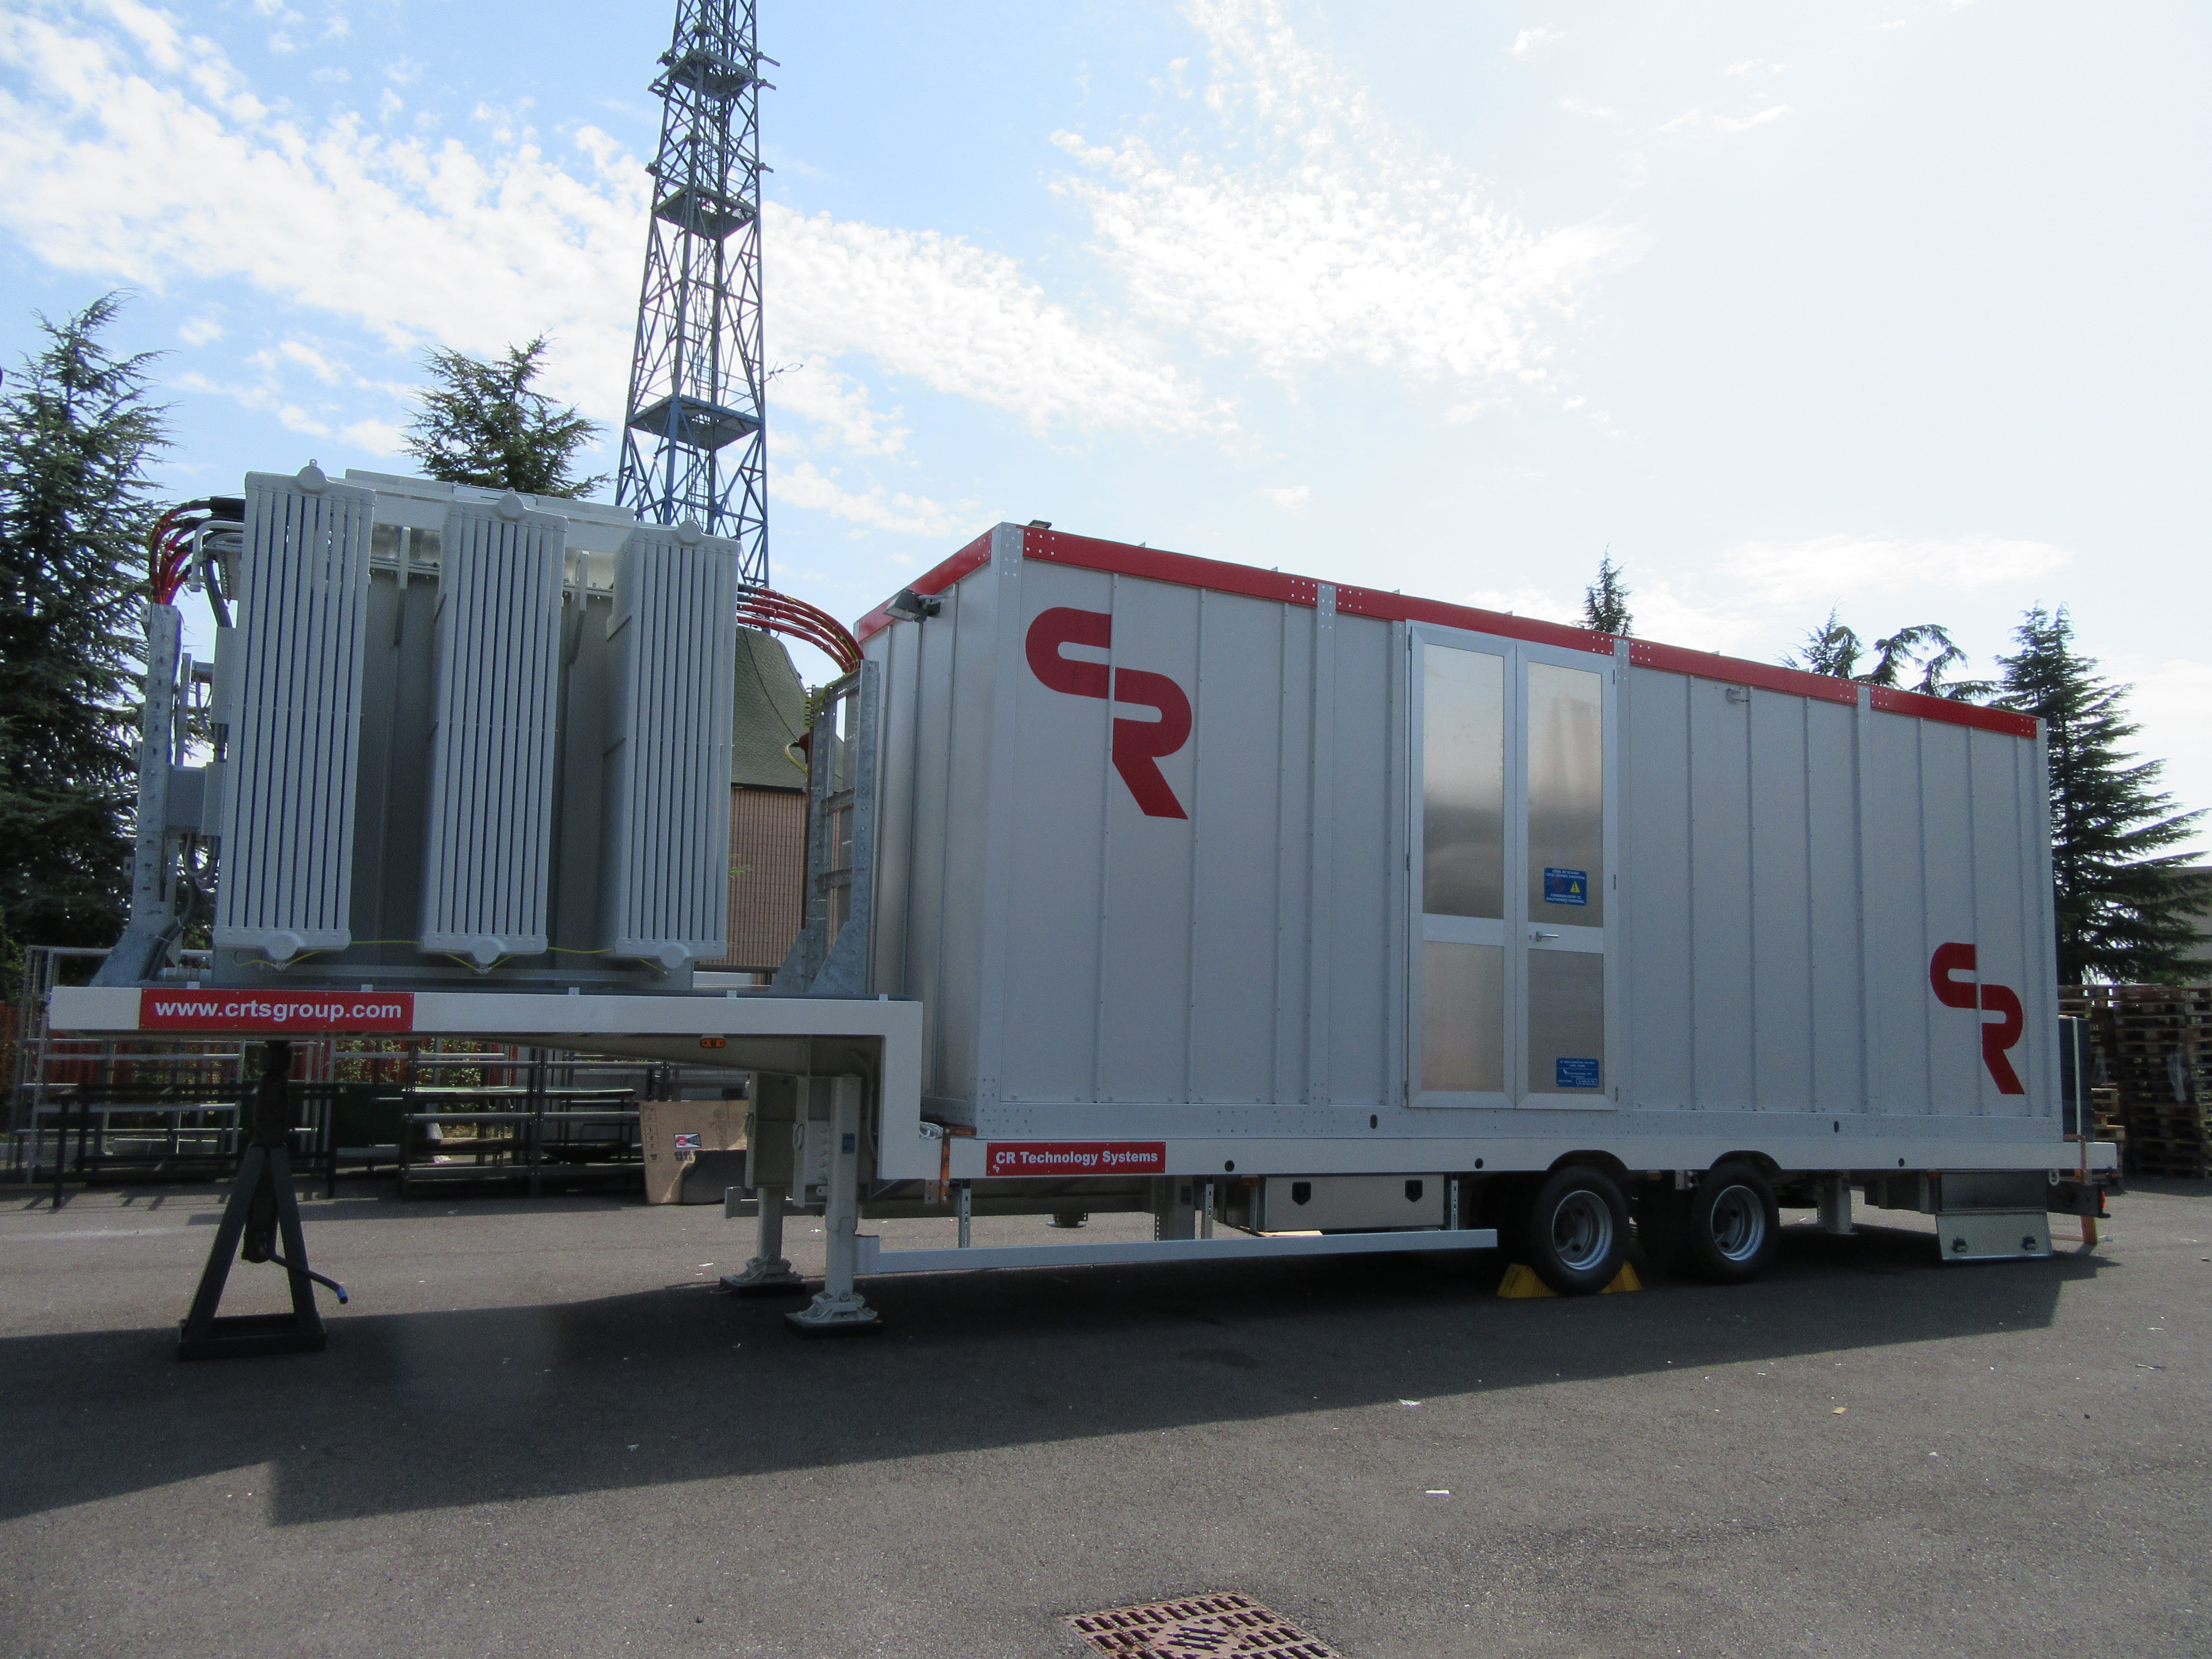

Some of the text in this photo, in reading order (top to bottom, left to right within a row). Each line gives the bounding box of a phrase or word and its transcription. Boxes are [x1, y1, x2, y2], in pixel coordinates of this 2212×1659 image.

[1025, 607, 1192, 820] CR
[155, 1000, 402, 1022] www.crtsgroup.com
[1930, 942, 2025, 1094] CR
[996, 1150, 1158, 1166] CR Technology Systems
